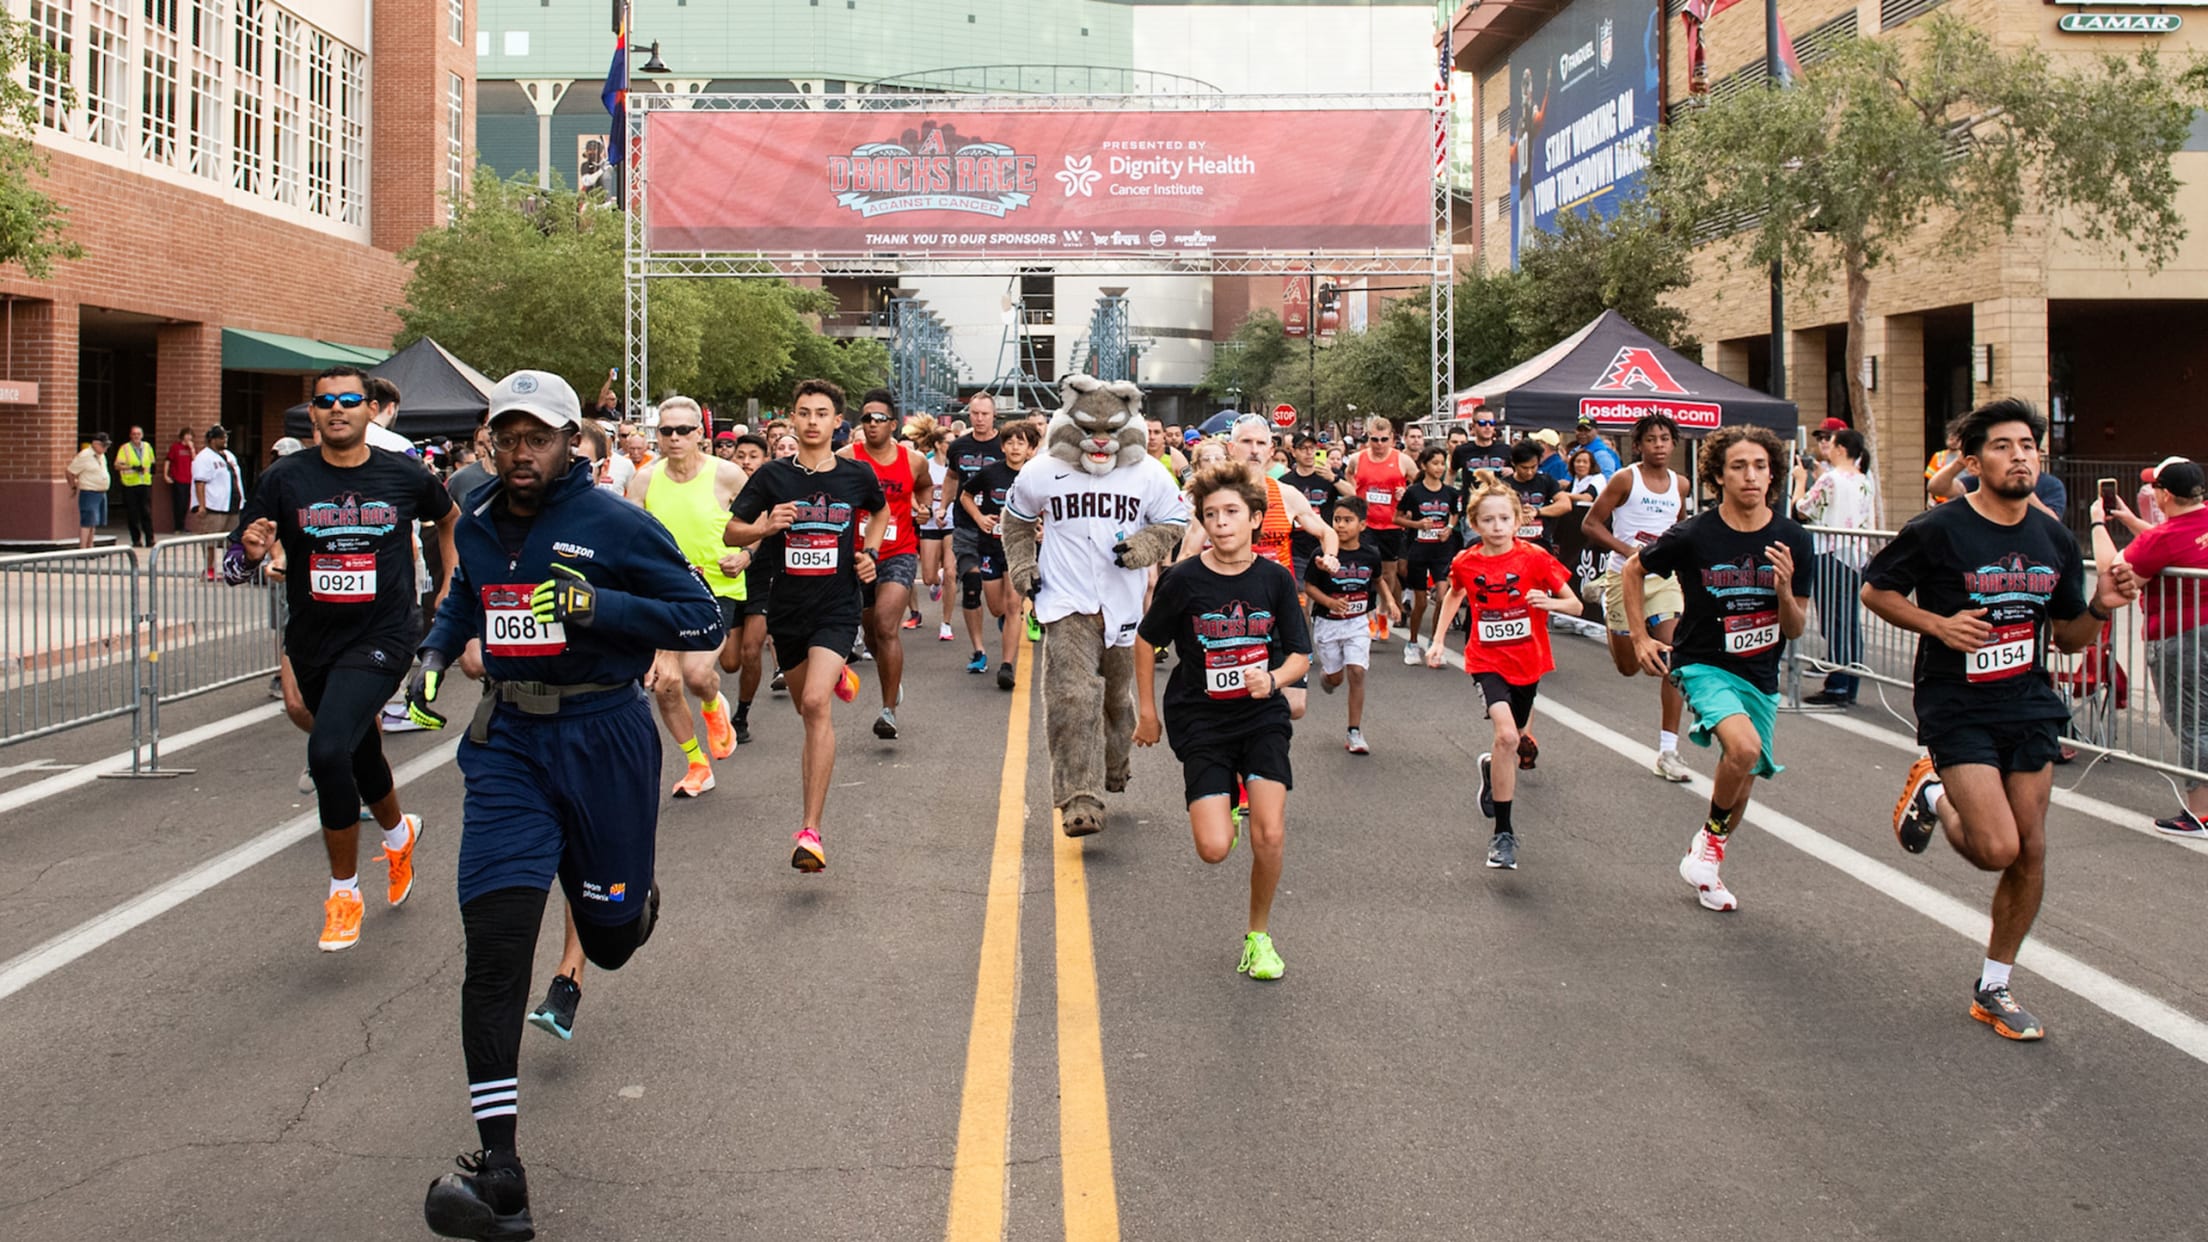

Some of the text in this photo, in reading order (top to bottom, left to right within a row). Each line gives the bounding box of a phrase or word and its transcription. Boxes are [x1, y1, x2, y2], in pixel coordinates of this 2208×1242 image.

[2071, 15, 2171, 29] LAMAR
[1545, 88, 1634, 173] START WORKING ON
[1102, 141, 1206, 150] PRESENTED BY
[954, 154, 1037, 192] RACE
[1109, 155, 1255, 180] Dignity Health
[1109, 183, 1204, 195] Cancer Institute
[1534, 175, 1557, 217] YOUR
[1556, 145, 1615, 206] TOUCHDOWN
[868, 197, 1000, 213] AGAINST CANCER
[865, 233, 909, 245] THANK
[912, 233, 938, 245] YOU
[941, 233, 957, 245] TO
[960, 233, 987, 245] OUR
[989, 233, 1057, 245] SPONSORS
[1274, 410, 1296, 421] STOP
[360, 506, 398, 526] RACE
[552, 541, 595, 559] amazon
[791, 551, 830, 566] 0954
[319, 575, 364, 591] 0921
[495, 616, 549, 639] 0681
[1485, 622, 1525, 639] 0592
[1734, 628, 1774, 650] 0245
[1976, 645, 2025, 669] 0154
[1215, 670, 1241, 688] 08
